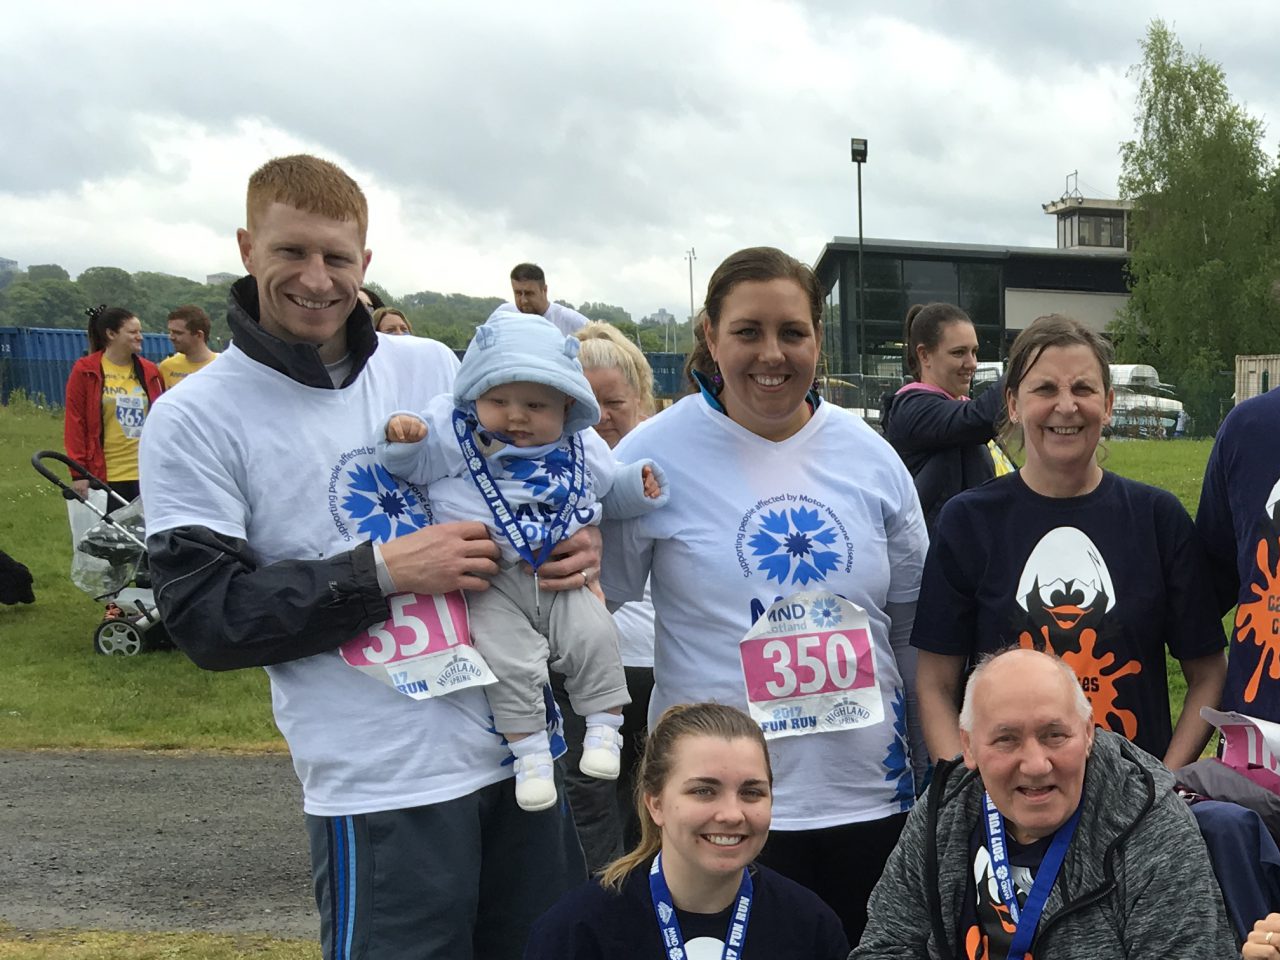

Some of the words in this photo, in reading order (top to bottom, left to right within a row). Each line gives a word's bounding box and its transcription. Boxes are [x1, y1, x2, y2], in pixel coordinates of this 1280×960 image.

[328, 464, 342, 494] people
[339, 446, 367, 466] affected
[755, 493, 785, 511] affected
[786, 493, 798, 502] by
[799, 494, 826, 509] Motor
[476, 472, 498, 499] 2017
[491, 499, 512, 523] FUN
[505, 525, 526, 548] RUN
[738, 508, 756, 532] people
[825, 507, 850, 541] Neurone
[735, 532, 753, 579] Supporting
[845, 541, 854, 574] Disease
[362, 592, 459, 665] 351
[436, 663, 482, 687] HIGHLAND
[763, 633, 857, 698] 350
[397, 680, 429, 695] RUN
[761, 718, 787, 732] FUN
[791, 715, 818, 729] RUN
[825, 706, 871, 725] HIGHLAND
[988, 812, 1002, 837] FUN
[991, 837, 1005, 863] 2017
[735, 896, 750, 922] RUN
[668, 927, 679, 947] MND
[729, 924, 745, 948] FUN
